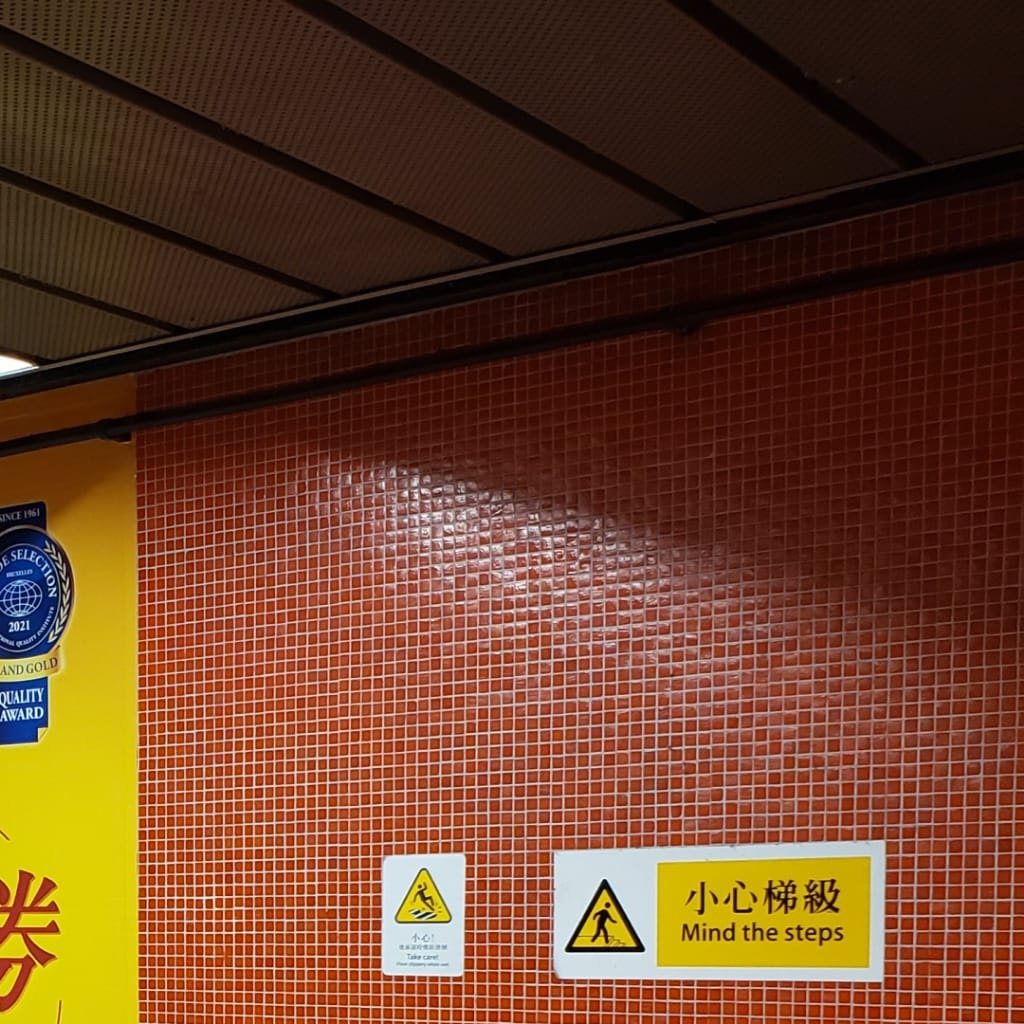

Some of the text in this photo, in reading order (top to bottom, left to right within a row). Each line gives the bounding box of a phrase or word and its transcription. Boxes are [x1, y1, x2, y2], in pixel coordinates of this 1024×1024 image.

[24, 507, 41, 519] 1961
[10, 549, 57, 598] SELECTION
[8, 620, 30, 632] 2021
[25, 656, 58, 674] GOLD
[0, 706, 44, 723] AWARD
[684, 878, 842, 916] 小心梯級
[681, 921, 844, 947] Mind the steps
